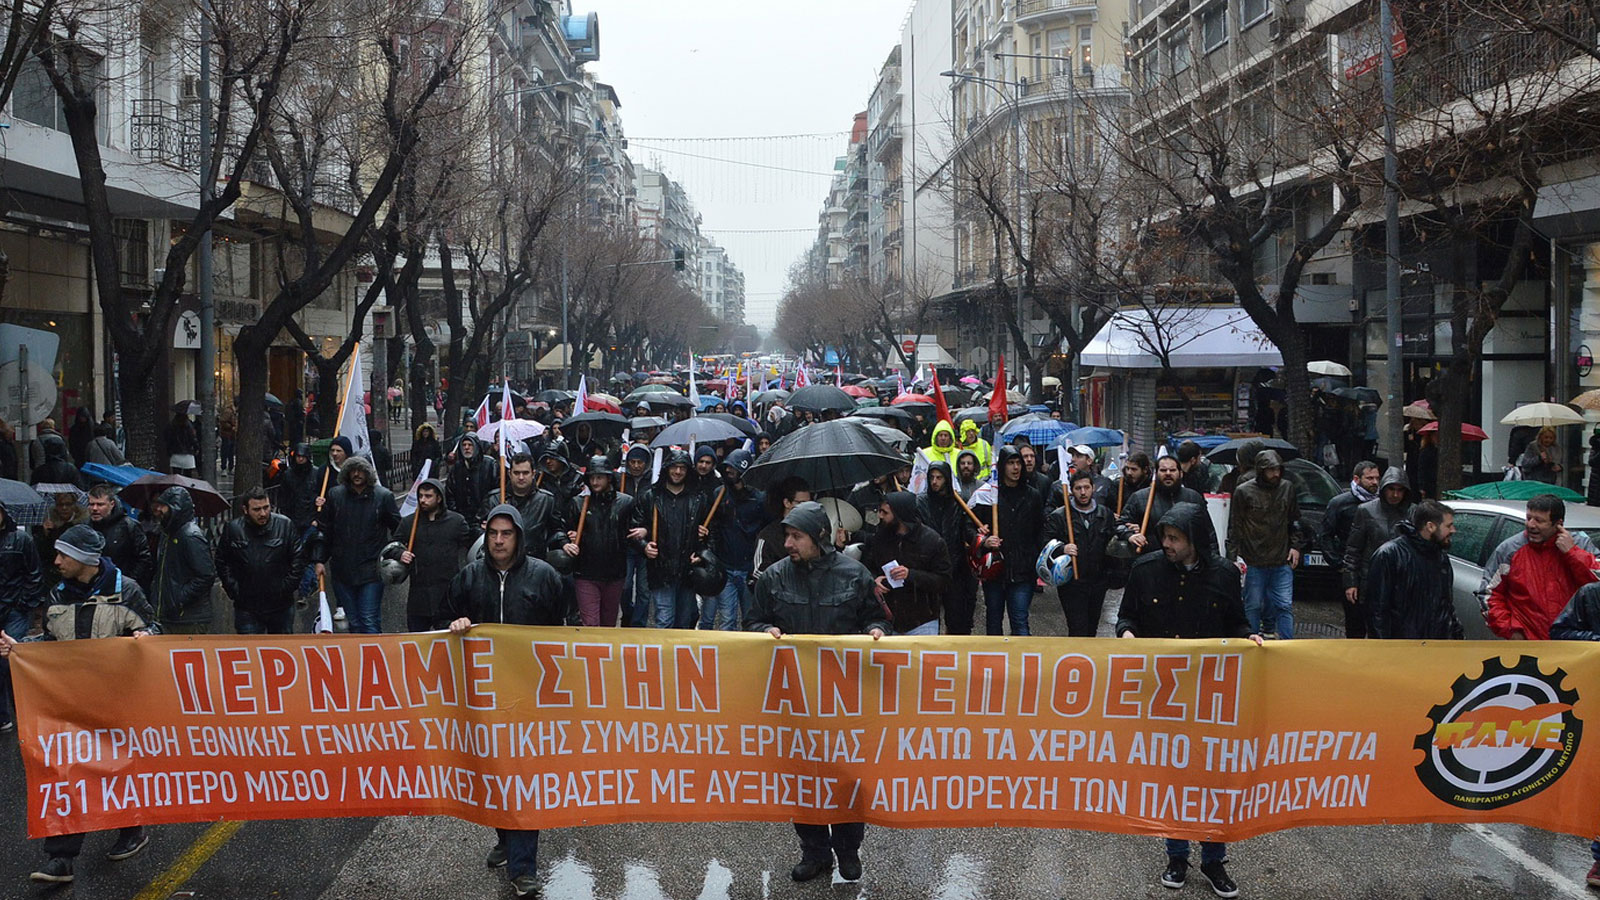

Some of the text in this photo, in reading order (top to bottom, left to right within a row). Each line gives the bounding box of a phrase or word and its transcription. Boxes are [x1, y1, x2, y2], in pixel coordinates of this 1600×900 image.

[170, 637, 1243, 726] ΠΕΡΝΑΜΕ ΣΤΗΝ ΑΝΤΕΠΙΘΕΣΗ
[38, 717, 1377, 772] ΥΠΟΓΡΑΦΗ ΕΘΝΙΚΗΣ ΓΕΝΙΚΗΣ ΣΥΛΛΟΓΙΚΗΣ ΣΥΜΒΑΣΗΣ ΕΡΓΑΣΙΑΣ / ΚΑΤΩ ΤΑ ΧΕΡΙΑ ΑΠΟ ΤΗΝ ΑΠΕΡΓΙΑ
[1556, 731, 1575, 769] ΜΕΤΩΠΟ
[39, 765, 1371, 825] 751 ΚΑΤΩΤΕΡΟ ΜΙΣΘΟ / ΚΛΑΔΙΚΕΣ ΣΥΜΒΑΣΕΙΣ ΜΕ ΑΥΞΗΣΕΙΣ / ΑΠΑΓΟΡΕΥΣΗ ΤΩΝ ΠΛΕΙΣΤΗΡΙΑΣΜΩΝ
